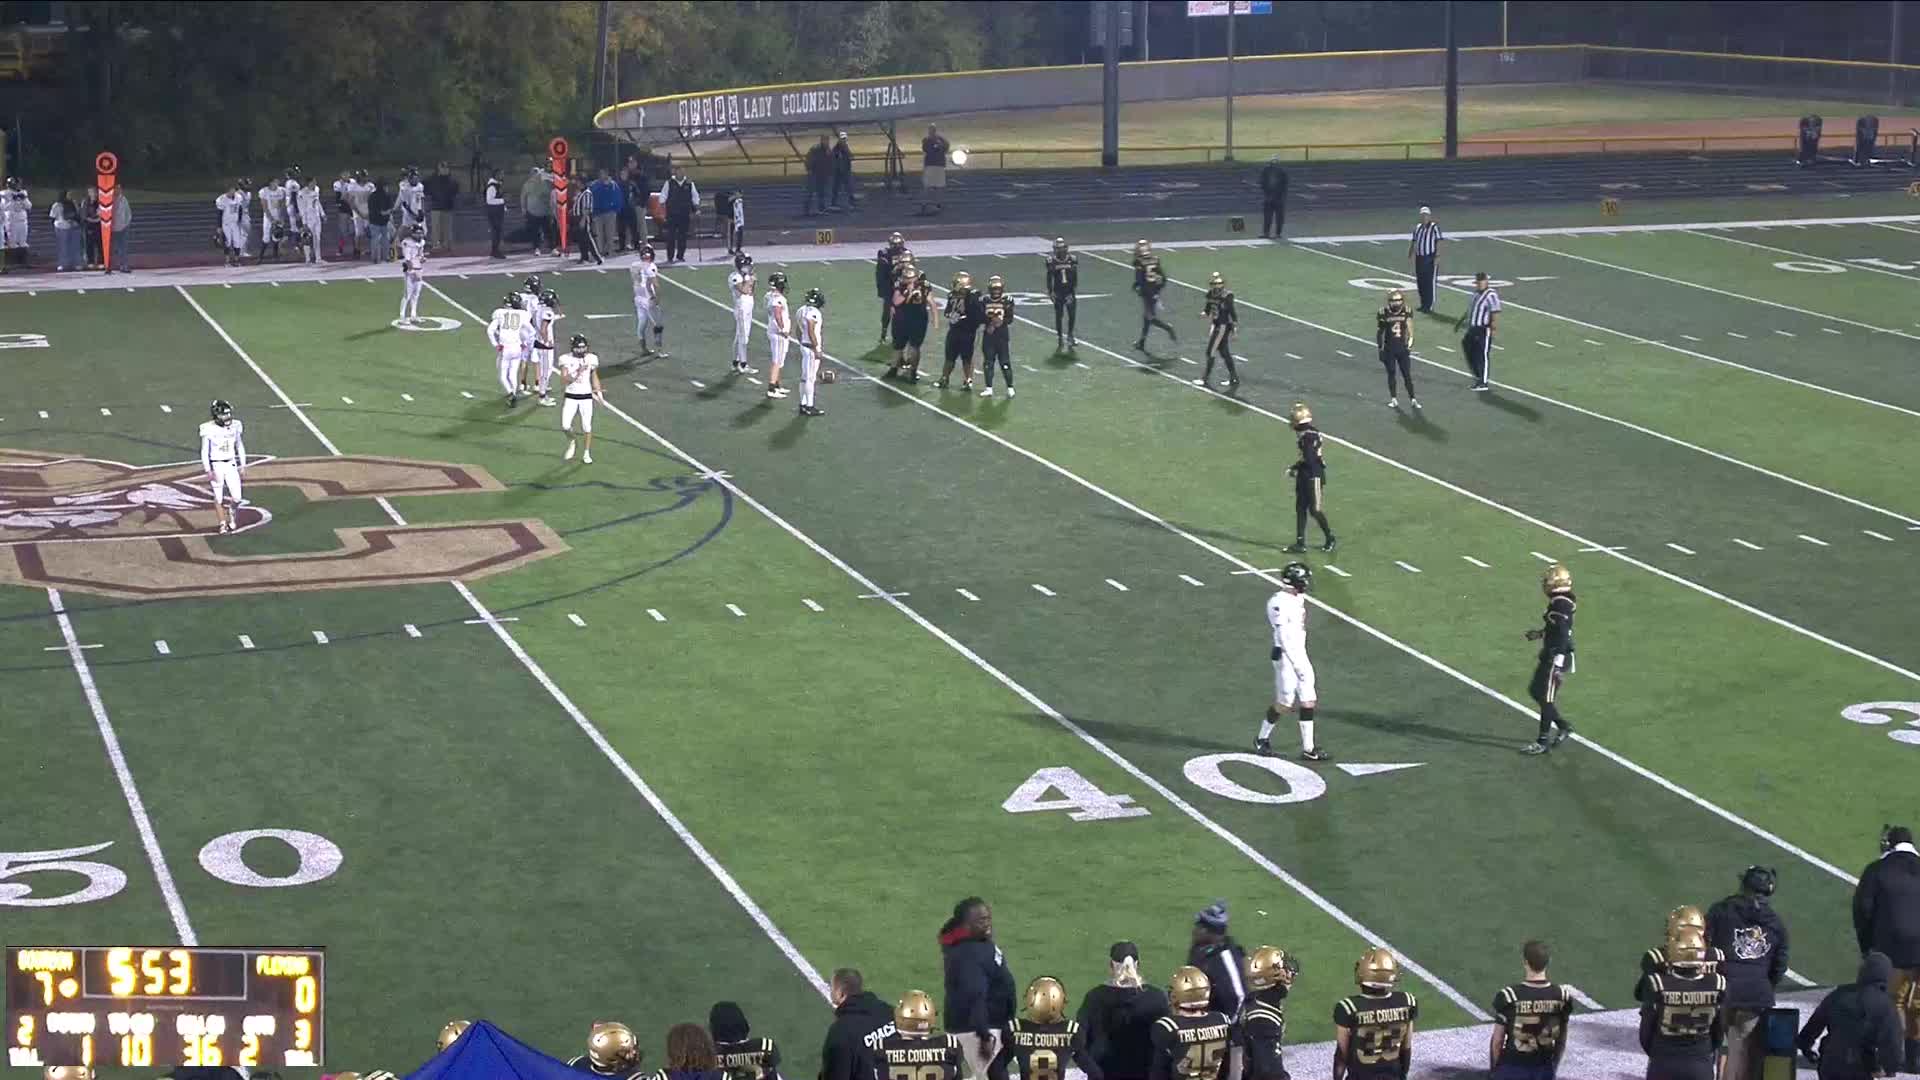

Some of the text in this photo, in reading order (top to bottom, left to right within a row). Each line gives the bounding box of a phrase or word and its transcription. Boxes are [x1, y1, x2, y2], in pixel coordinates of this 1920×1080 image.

[744, 97, 773, 119] LADY
[782, 91, 840, 115] COLONELS
[850, 84, 916, 109] SOFTBALL
[818, 231, 832, 245] 30
[502, 311, 524, 331] 10
[1390, 321, 1402, 338] 4
[34, 971, 53, 1006] 7
[295, 975, 316, 1014] 0
[1662, 990, 1720, 1005] THE COUNTY
[1356, 1011, 1376, 1025] THE
[1515, 1000, 1532, 1013] THE
[17, 1015, 34, 1046] 2
[294, 1019, 312, 1049] 3
[1013, 1032, 1073, 1047] THE COUNTY
[1178, 1029, 1197, 1043] THE
[81, 1034, 93, 1067] 1
[120, 1034, 153, 1067] 10
[183, 1033, 223, 1067] 36
[239, 1033, 260, 1067] 2
[885, 1048, 945, 1063] THE COUNTY
